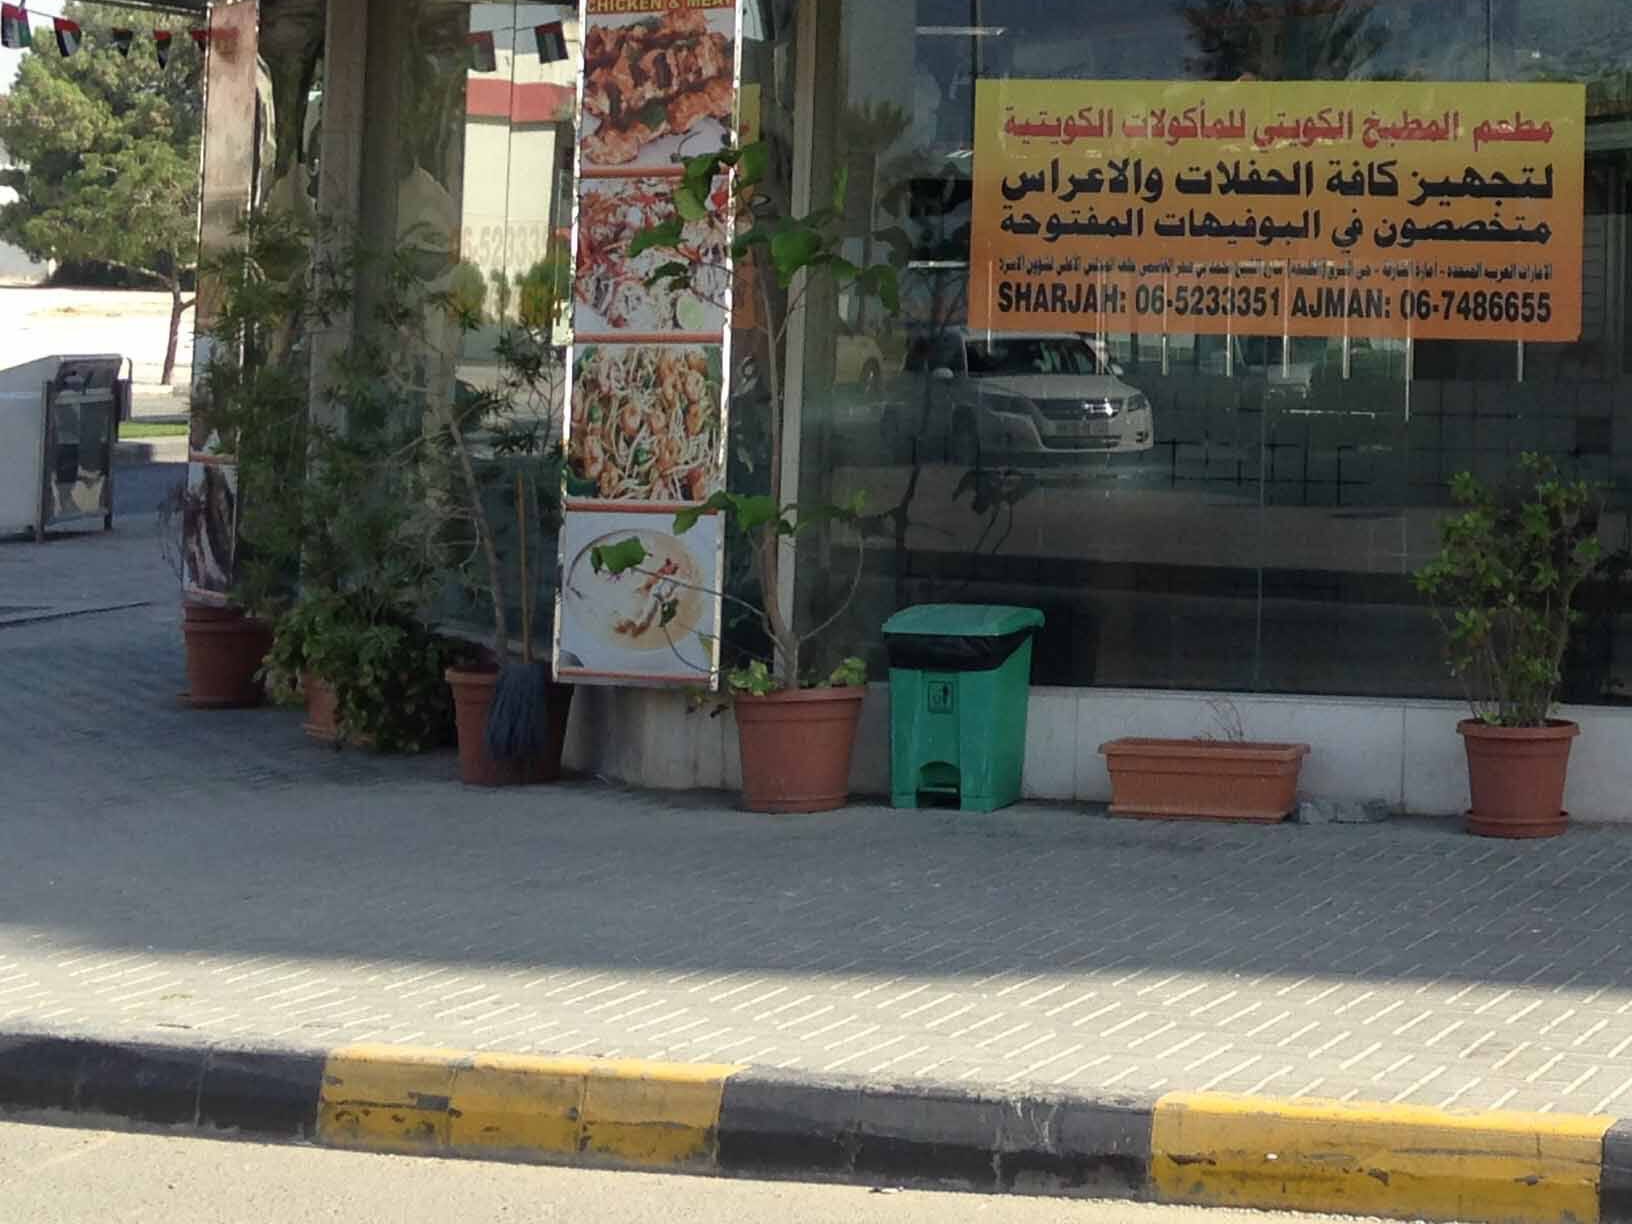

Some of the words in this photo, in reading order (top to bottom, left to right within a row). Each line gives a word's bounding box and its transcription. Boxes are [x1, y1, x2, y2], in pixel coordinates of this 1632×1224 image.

[1003, 105, 1114, 146] الكويتية
[1253, 107, 1354, 154] الكويتي
[1362, 109, 1460, 149] المطبخ
[1473, 111, 1554, 153] مطعم
[1000, 156, 1164, 204] والاعراس
[1174, 159, 1315, 198] الحفلات
[1325, 159, 1399, 198] كافة
[1406, 162, 1554, 208] لتجهيز
[999, 203, 1145, 243] المفتوحة
[1153, 206, 1321, 246] البوفيهات
[1330, 207, 1364, 255] في
[1372, 211, 1553, 249] متخصصون
[996, 279, 1127, 314] SHARJAH:
[1134, 282, 1281, 317] 06-5233351
[1290, 285, 1392, 319] AJMAN:
[1399, 288, 1553, 324] 06-7486655
